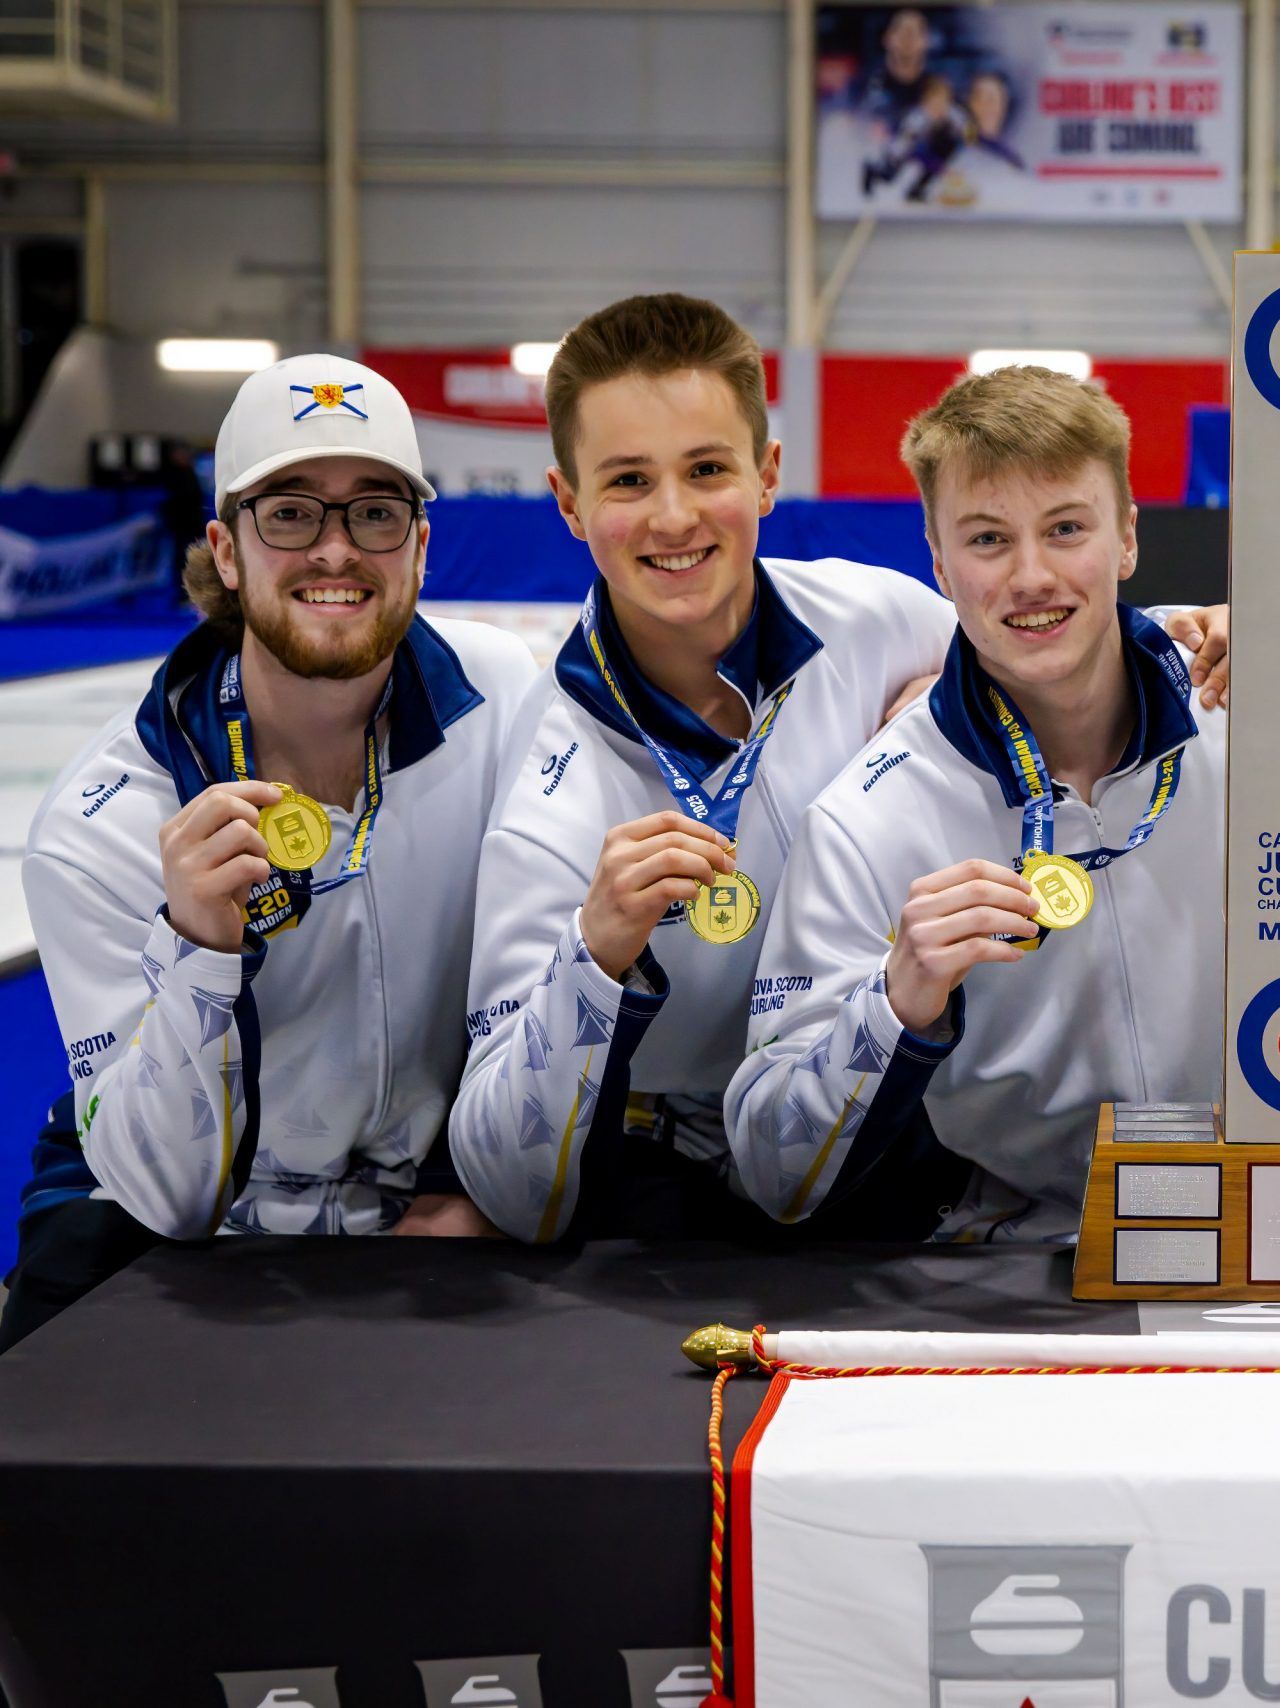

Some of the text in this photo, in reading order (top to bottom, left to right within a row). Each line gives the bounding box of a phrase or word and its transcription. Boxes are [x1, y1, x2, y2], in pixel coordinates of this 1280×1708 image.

[1166, 648, 1185, 680] CANADA
[227, 719, 248, 774] CANADIEN
[542, 741, 579, 796] Goldline
[862, 751, 911, 792] Goldline
[1014, 739, 1045, 800] CANADIAN
[82, 773, 130, 818] Goldline
[686, 794, 709, 819] 2025
[1032, 805, 1043, 840] HOLLAND
[241, 888, 290, 924] -20
[249, 903, 293, 934] NADIEN
[753, 975, 814, 996] OVA SCOTIA
[750, 993, 786, 1016] URLING
[70, 1031, 117, 1061] SCOTIA
